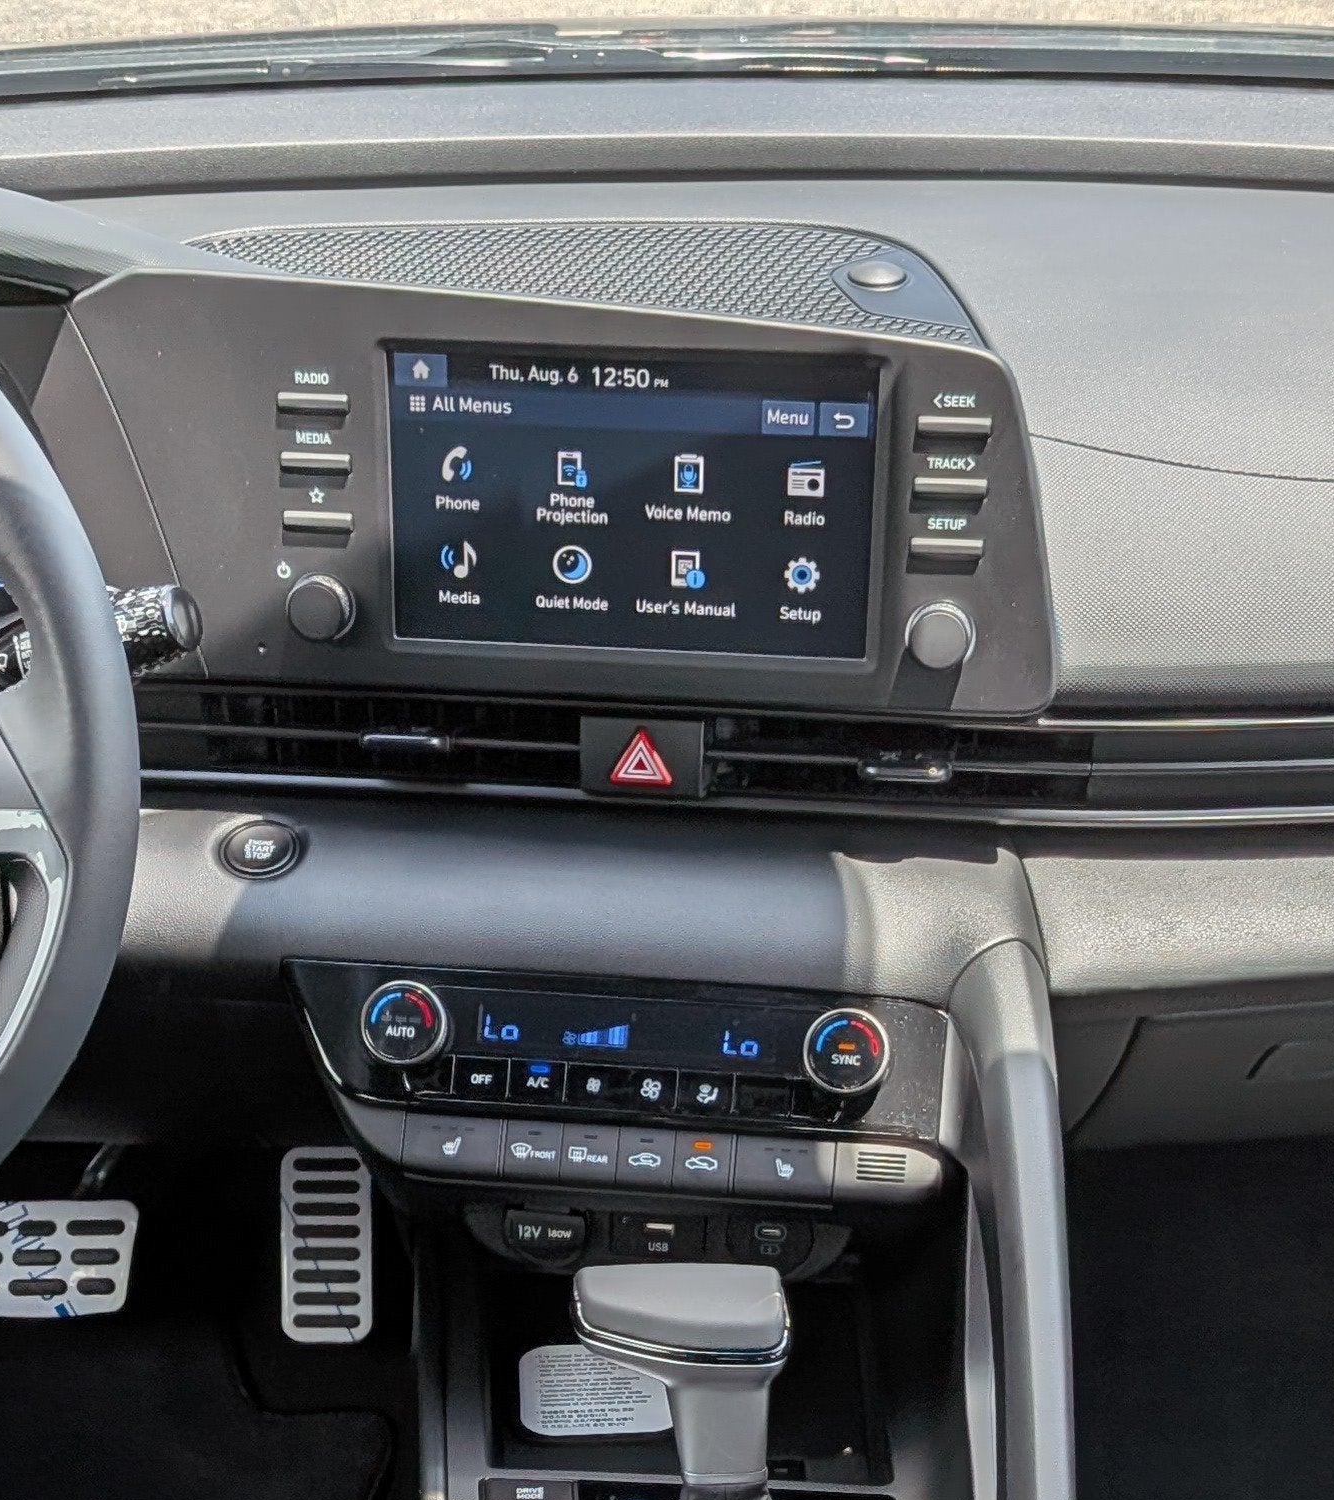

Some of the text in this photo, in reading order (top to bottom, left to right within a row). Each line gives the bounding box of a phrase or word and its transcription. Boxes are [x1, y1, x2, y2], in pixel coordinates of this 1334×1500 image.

[294, 371, 329, 385] RADIO
[489, 364, 668, 389] Thu, Aug. 6 12:50 PM
[433, 396, 512, 415] All Menus
[768, 410, 809, 426] Menu
[295, 430, 332, 445] MEDIA
[435, 496, 480, 512] Phone
[550, 493, 595, 508] Phone
[536, 508, 608, 526] Projection
[645, 504, 731, 522] Voice Memo
[784, 510, 825, 526] Radio
[927, 518, 967, 531] SETUP
[439, 590, 481, 605] Media
[535, 596, 609, 611] Quiet Mode
[636, 599, 735, 618] User's Manual
[780, 606, 821, 623] Setup
[244, 843, 276, 854] START
[245, 851, 272, 860] STOP
[385, 1025, 415, 1039] AUTO
[484, 1013, 519, 1042] Lo
[722, 1030, 760, 1057] Lo
[831, 1053, 862, 1067] SYNC
[470, 1073, 493, 1085] OFF
[526, 1075, 549, 1089] A/C
[530, 1150, 556, 1161] FRONT
[586, 1154, 608, 1164] REAR
[518, 1223, 572, 1240] 12V 180W
[647, 1241, 668, 1253] USB
[516, 1486, 544, 1494] DRIVE
[516, 1492, 544, 1500] MODE
